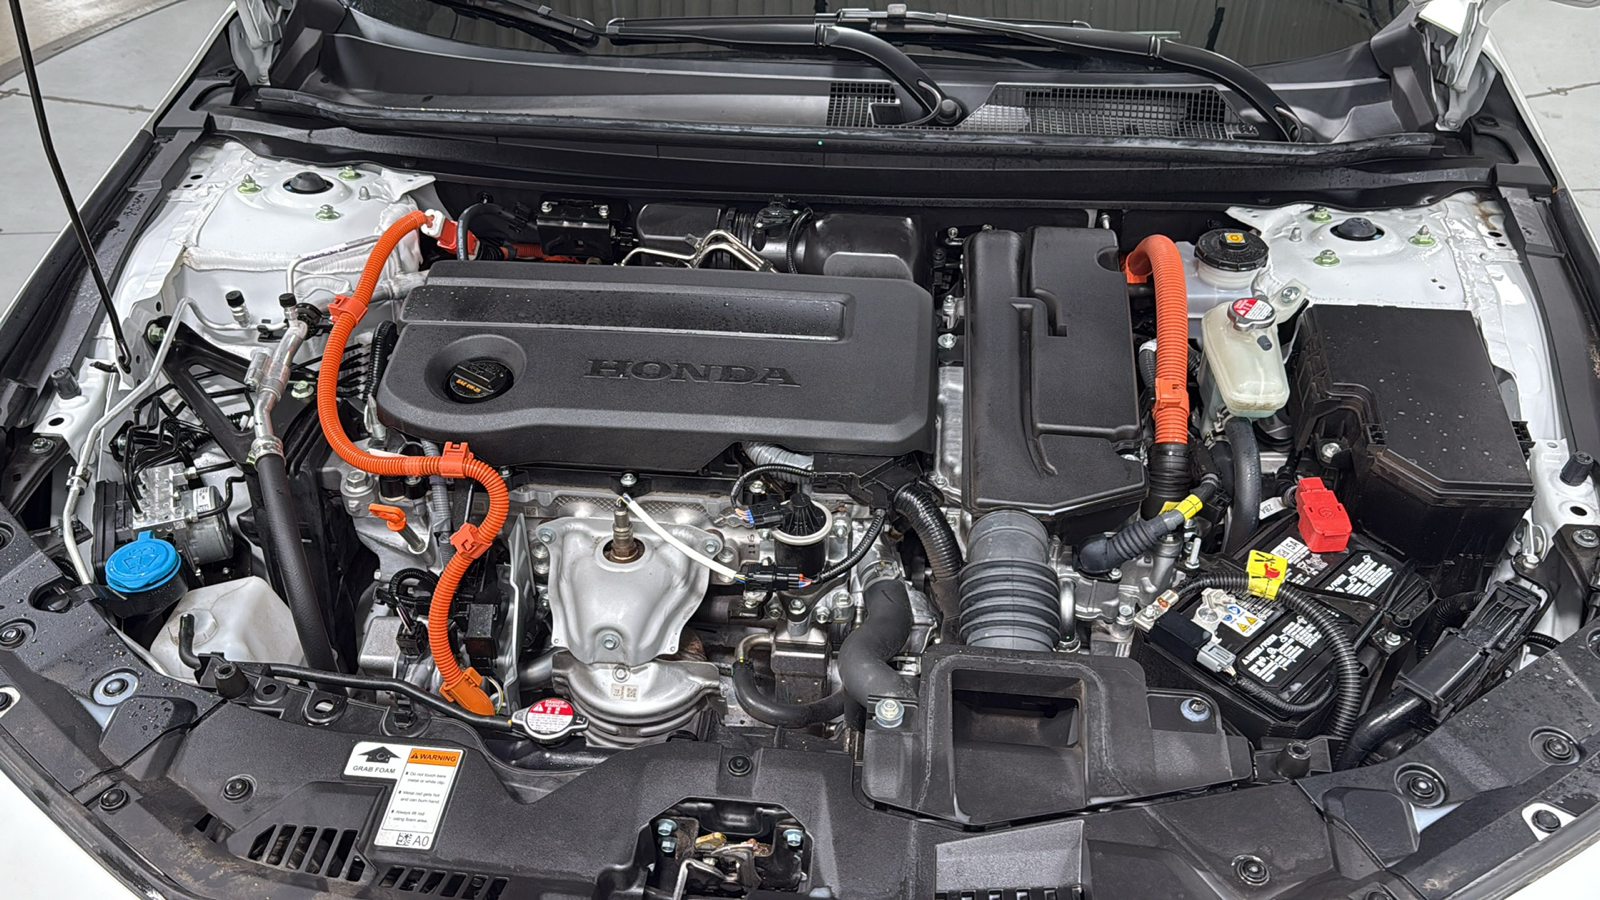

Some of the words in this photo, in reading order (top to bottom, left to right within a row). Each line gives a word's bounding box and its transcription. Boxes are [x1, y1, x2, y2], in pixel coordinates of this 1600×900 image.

[584, 358, 801, 388] HONDA
[420, 753, 456, 763] WARNING
[353, 765, 374, 773] GRAB
[374, 766, 396, 774] FOAM
[412, 835, 430, 847] A0
